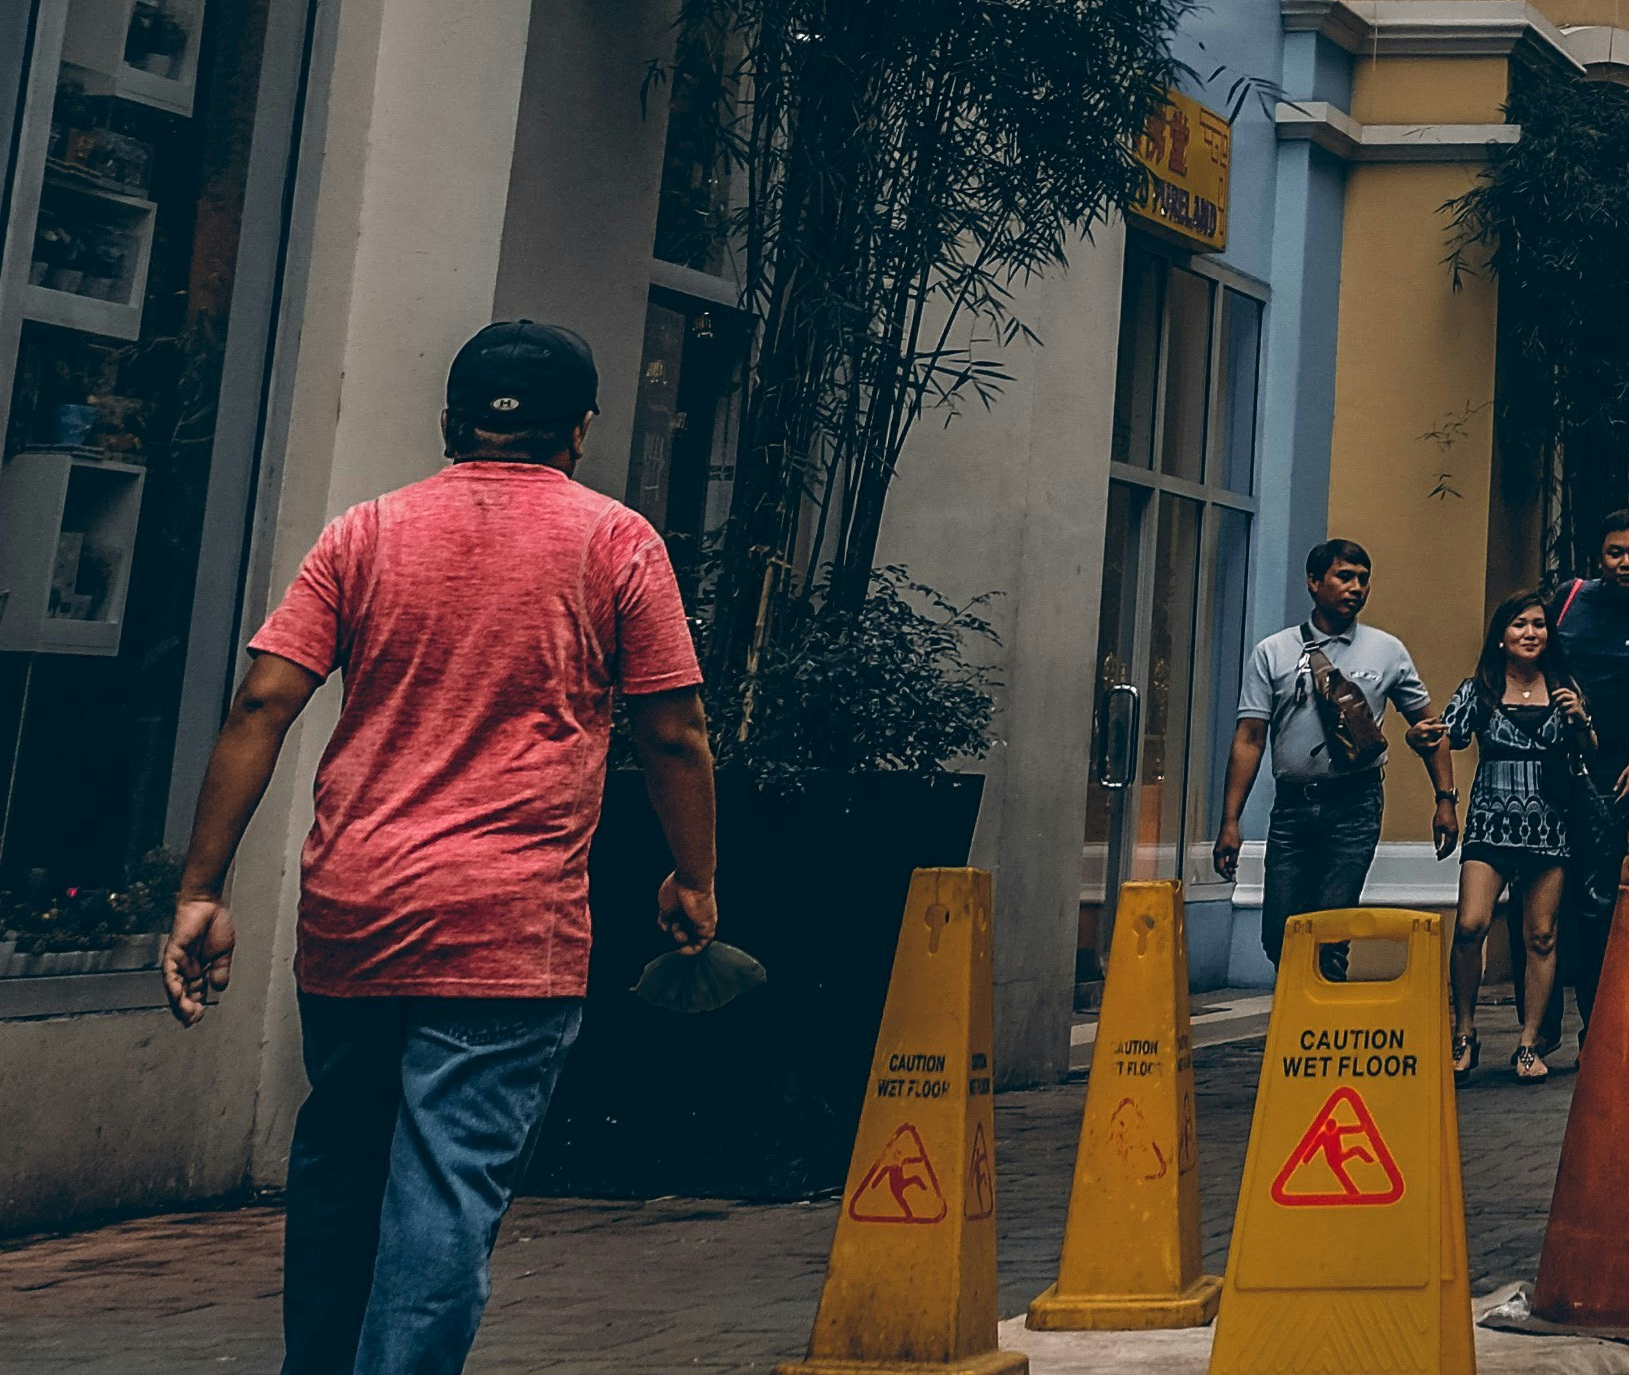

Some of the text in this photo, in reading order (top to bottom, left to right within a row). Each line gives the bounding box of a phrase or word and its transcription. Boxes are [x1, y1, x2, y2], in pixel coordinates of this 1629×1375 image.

[1113, 1039, 1159, 1055] AUTION
[1300, 1029, 1404, 1050] CAUTION
[889, 1054, 945, 1072] CAUTION
[1283, 1055, 1417, 1077] WET FLOOR
[878, 1079, 905, 1097] WET
